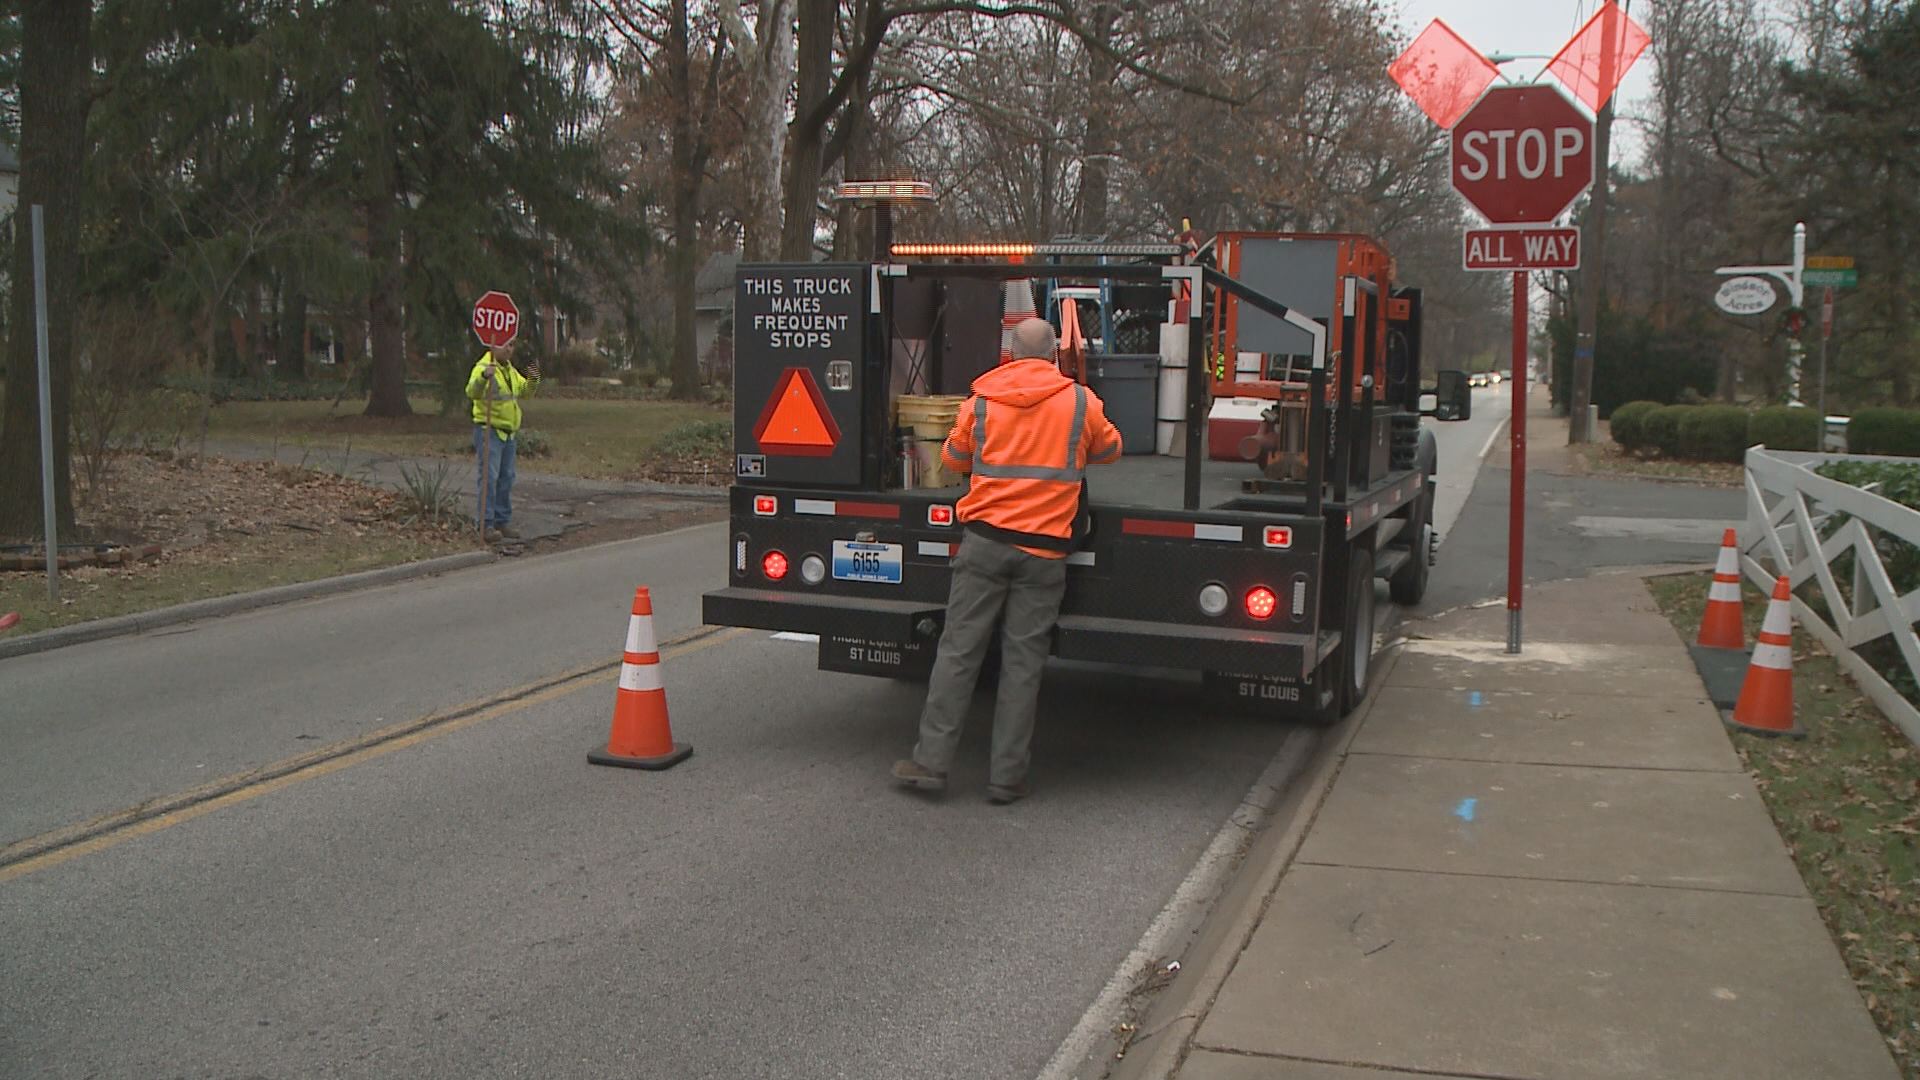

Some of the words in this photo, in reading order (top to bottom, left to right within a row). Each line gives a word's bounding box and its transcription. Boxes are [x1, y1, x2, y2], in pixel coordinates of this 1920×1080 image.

[1460, 127, 1584, 181] STOP
[1467, 236, 1513, 263] ALL
[1524, 235, 1576, 262] WAY
[744, 278, 783, 295] THIS
[793, 278, 852, 295] TRUCK
[771, 297, 821, 314] MAKES
[475, 307, 516, 332] STOP
[754, 315, 849, 331] FREQUENT
[770, 332, 832, 349] STOPS
[853, 551, 880, 573] 6155
[849, 647, 864, 661] ST
[867, 649, 901, 665] LOUIS
[1239, 682, 1256, 697] ST
[1261, 685, 1300, 702] LOUIS
